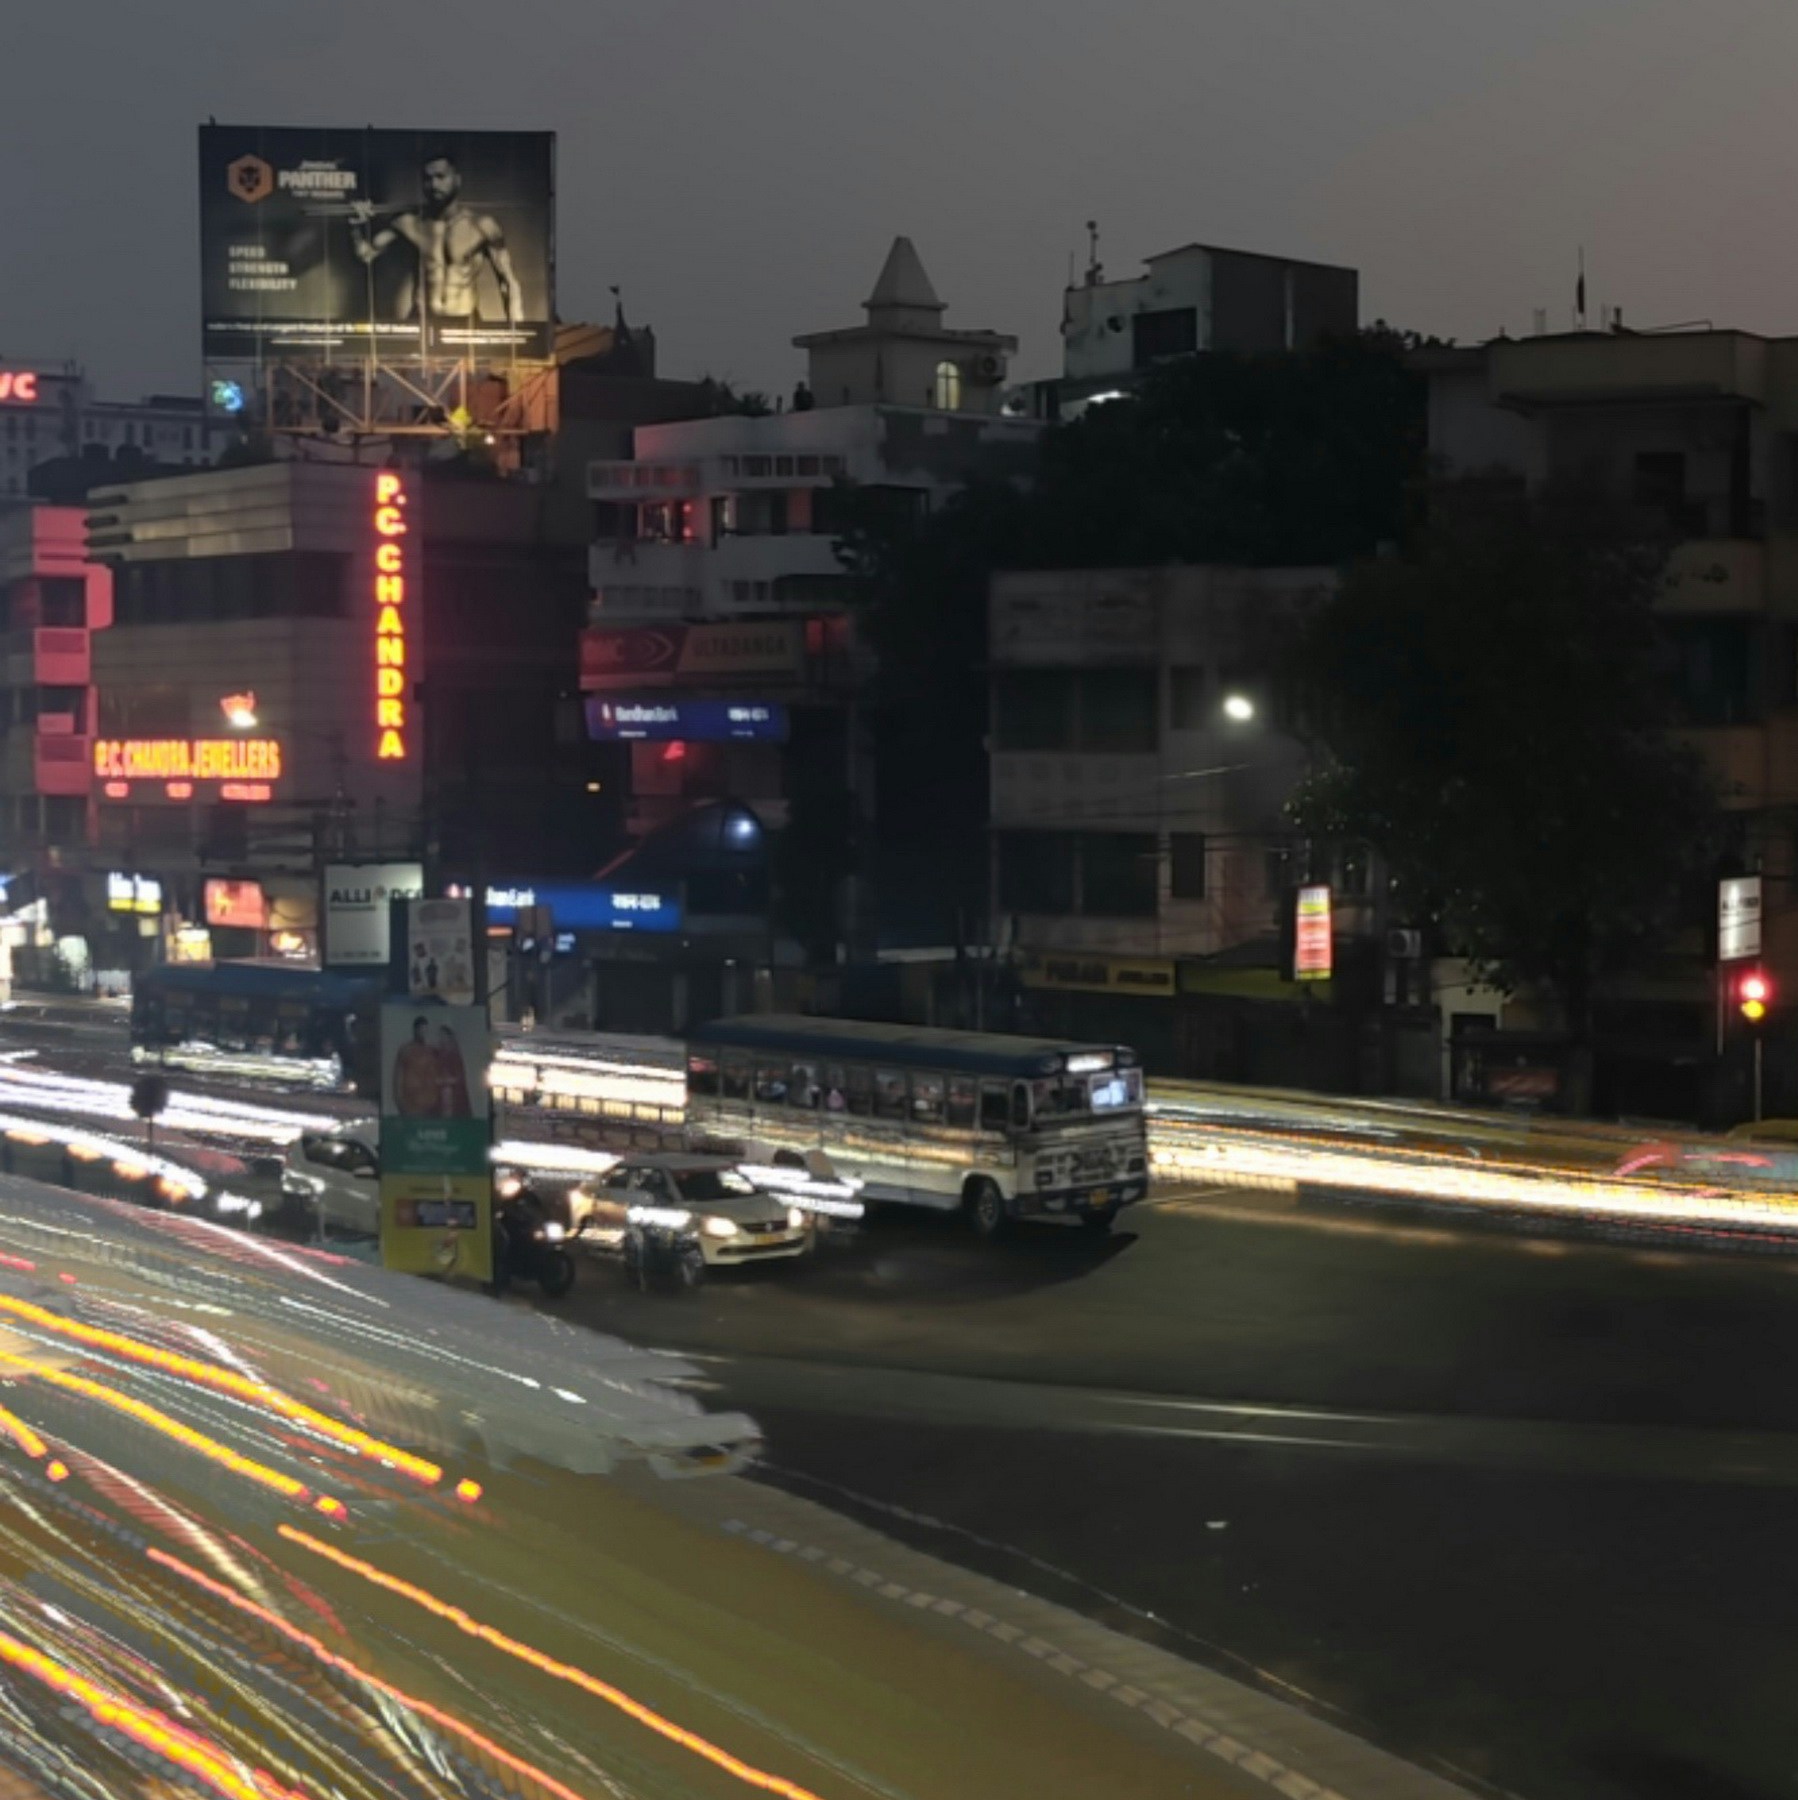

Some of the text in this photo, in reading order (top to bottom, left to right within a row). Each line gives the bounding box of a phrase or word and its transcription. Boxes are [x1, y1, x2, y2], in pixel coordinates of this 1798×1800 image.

[278, 171, 357, 189] PANTHER
[228, 278, 298, 290] FLEXIBILITY
[376, 543, 405, 759] CHANDRA
[191, 739, 281, 779] JEWELLERS
